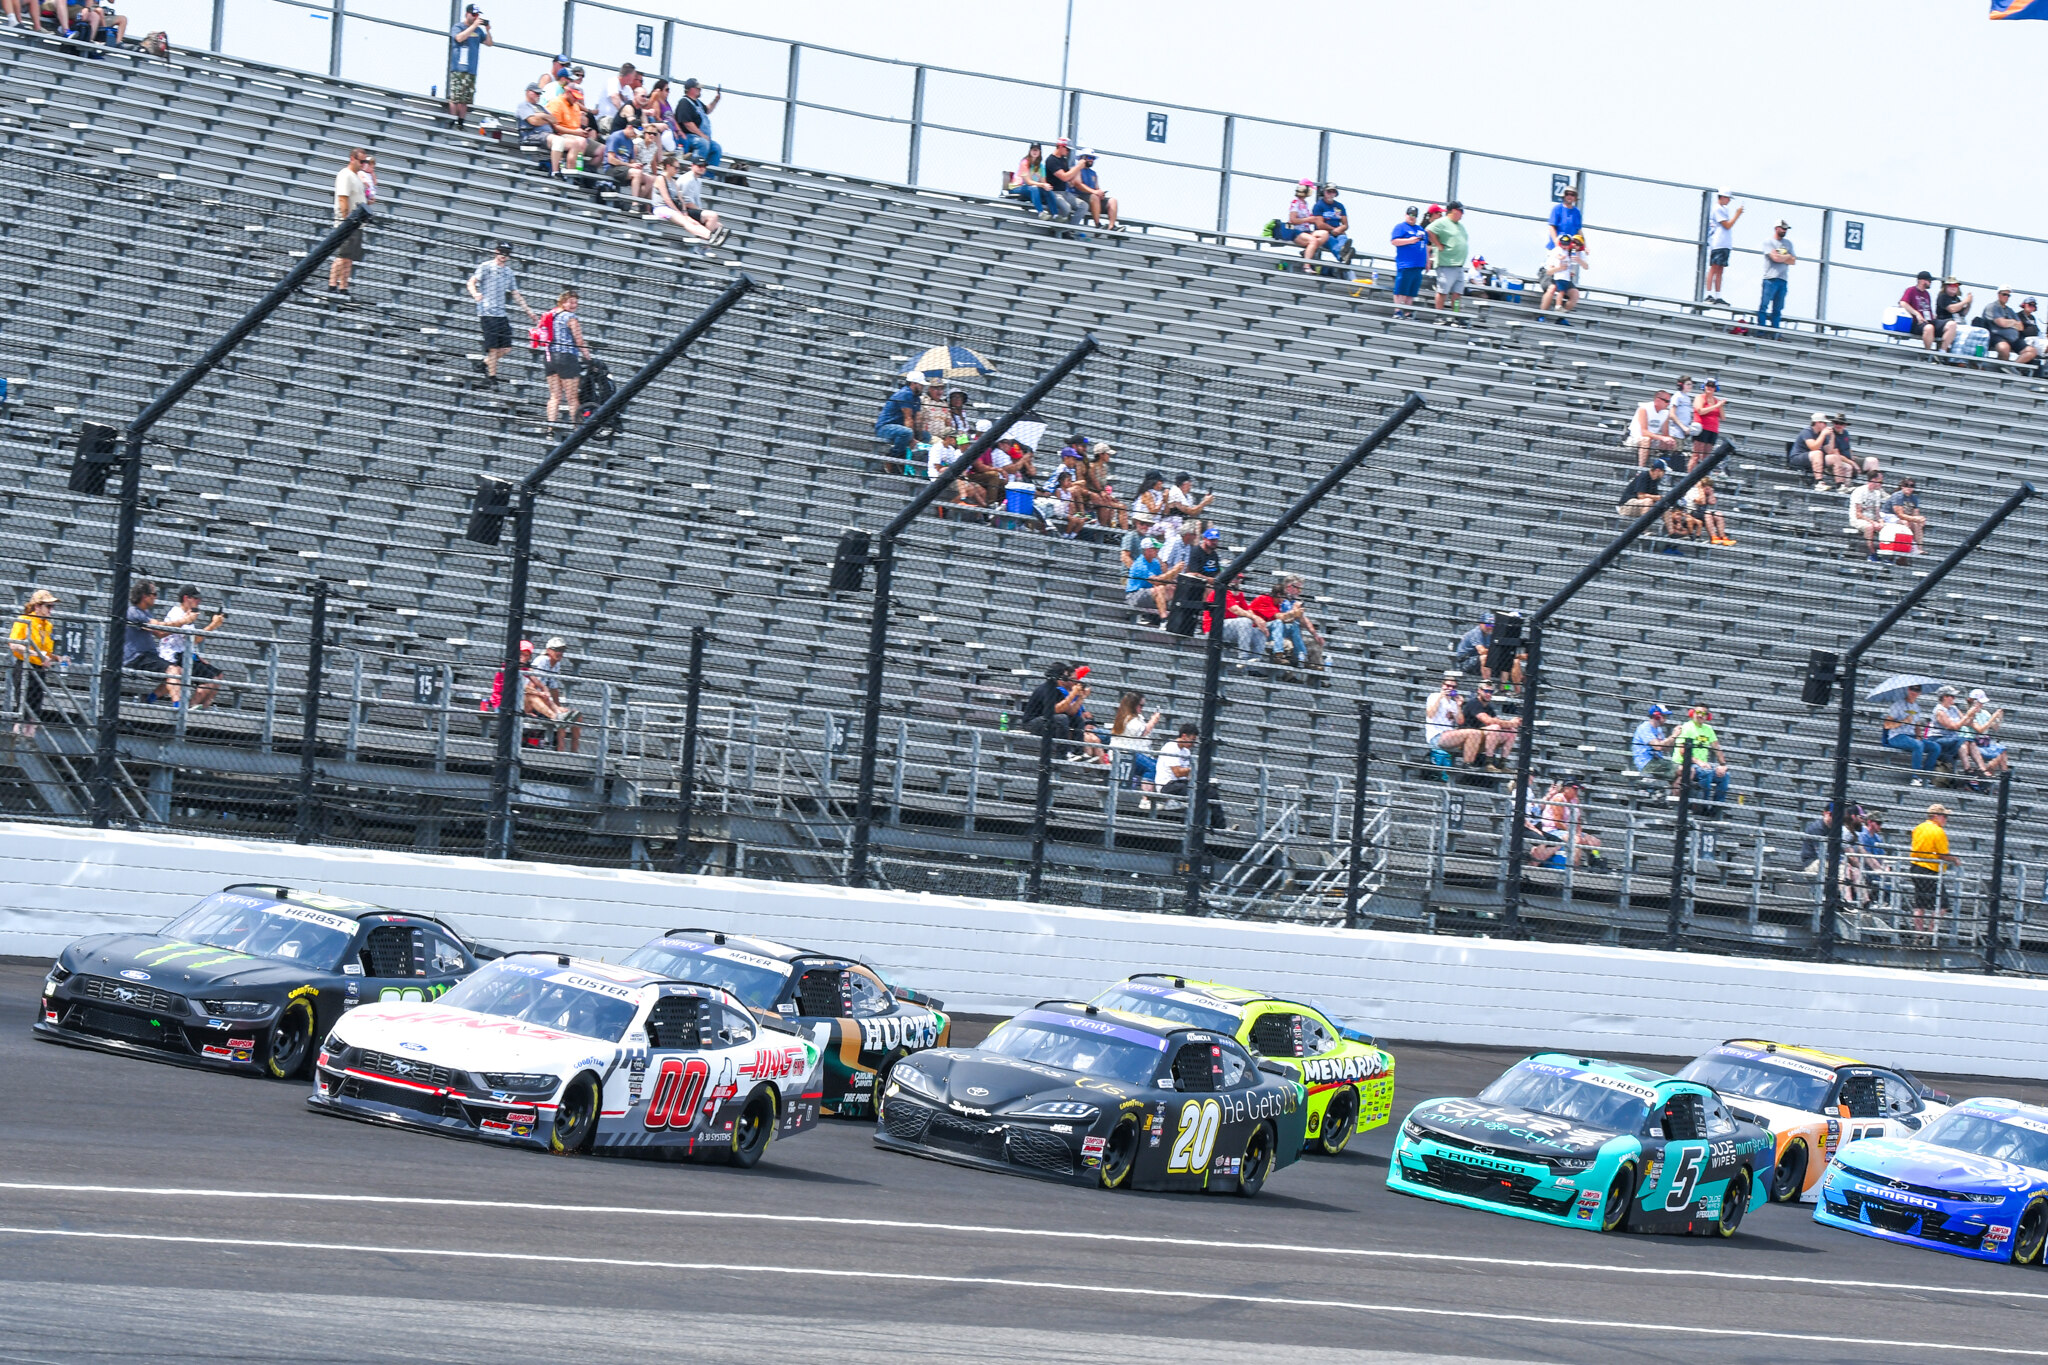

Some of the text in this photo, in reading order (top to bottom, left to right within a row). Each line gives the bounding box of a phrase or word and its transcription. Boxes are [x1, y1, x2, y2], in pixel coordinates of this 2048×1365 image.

[638, 33, 651, 49] 20
[1150, 120, 1164, 137] 21
[1847, 228, 1862, 244] 23
[66, 631, 81, 653] 14
[418, 675, 433, 695] 15
[1120, 762, 1132, 781] 17
[1703, 835, 1714, 852] 19
[217, 895, 263, 908] xfinity
[285, 908, 347, 928] HERBST
[659, 938, 704, 951] xfinity
[729, 952, 772, 967] MAYER
[495, 963, 544, 976] xfinity
[288, 984, 319, 999] GOODYEAR
[568, 976, 629, 997] CUSTER
[1122, 982, 1166, 995] xfinity
[1192, 997, 1228, 1010] JONES
[859, 1014, 937, 1050] HUCK'S
[1065, 1018, 1116, 1034] xfinity
[1718, 1047, 1758, 1059] xfinity
[574, 1056, 605, 1069] GOODYEAR
[737, 1046, 803, 1081] HAAS
[981, 1056, 1066, 1079] Gets
[1302, 1054, 1382, 1081] MENARDS
[1526, 1062, 1571, 1076] xfinity
[644, 1057, 710, 1129] 00
[1591, 1076, 1655, 1098] ALFREDO
[949, 1100, 992, 1117] Supra
[1120, 1099, 1144, 1110] GOODYEAR
[1219, 1085, 1296, 1125] He Gets Us
[508, 1113, 534, 1122] SIMPSON
[1959, 1107, 2000, 1119] xfinity
[2023, 1120, 2048, 1131] KVA
[711, 1132, 732, 1141] SYSTEMS
[1085, 1137, 1104, 1145] SIMPSON
[1167, 1098, 1221, 1174] 20
[1509, 1127, 1574, 1154] CHILL
[1709, 1140, 1736, 1157] DUDE
[1435, 1149, 1525, 1174] CAMARO
[1619, 1151, 1640, 1163] GOODYEAR
[1711, 1154, 1736, 1169] WIPES
[1665, 1146, 1705, 1212] 5
[1577, 1199, 1599, 1207] ARP
[1854, 1182, 1938, 1210] CAMARO
[1985, 1233, 2008, 1241] ARP
[1991, 1226, 2009, 1235] SIMPSON
